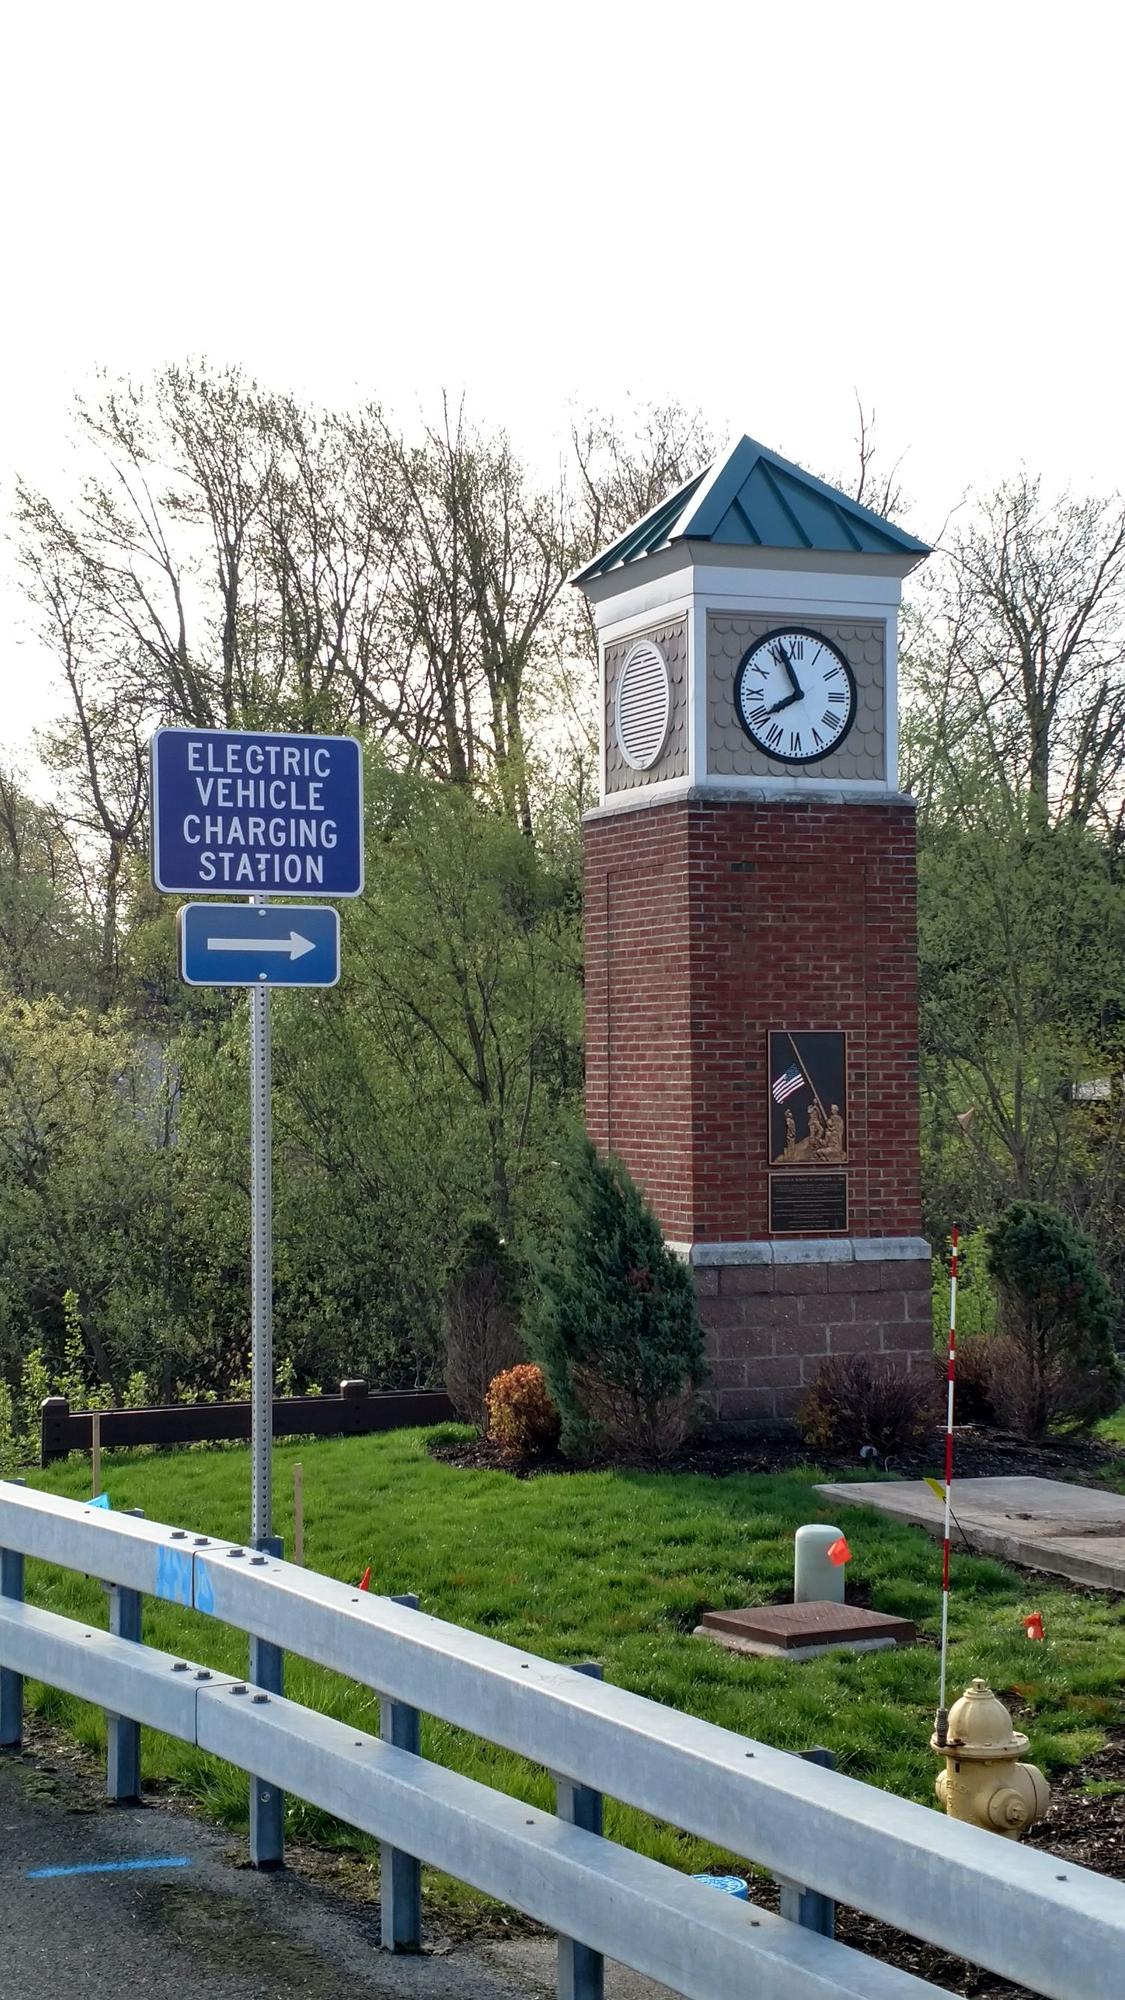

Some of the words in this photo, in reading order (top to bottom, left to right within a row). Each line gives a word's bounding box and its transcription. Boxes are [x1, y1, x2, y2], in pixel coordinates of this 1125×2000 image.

[789, 641, 804, 660] XII
[752, 663, 770, 680] X
[823, 667, 840, 681] II
[746, 688, 764, 701] IX
[828, 692, 846, 703] III
[766, 723, 784, 747] VII
[812, 728, 824, 747] V
[187, 742, 331, 778] ELECTRIC
[196, 777, 325, 811] VEHICLE
[183, 814, 338, 849] CHARGING
[199, 851, 324, 884] STATION
